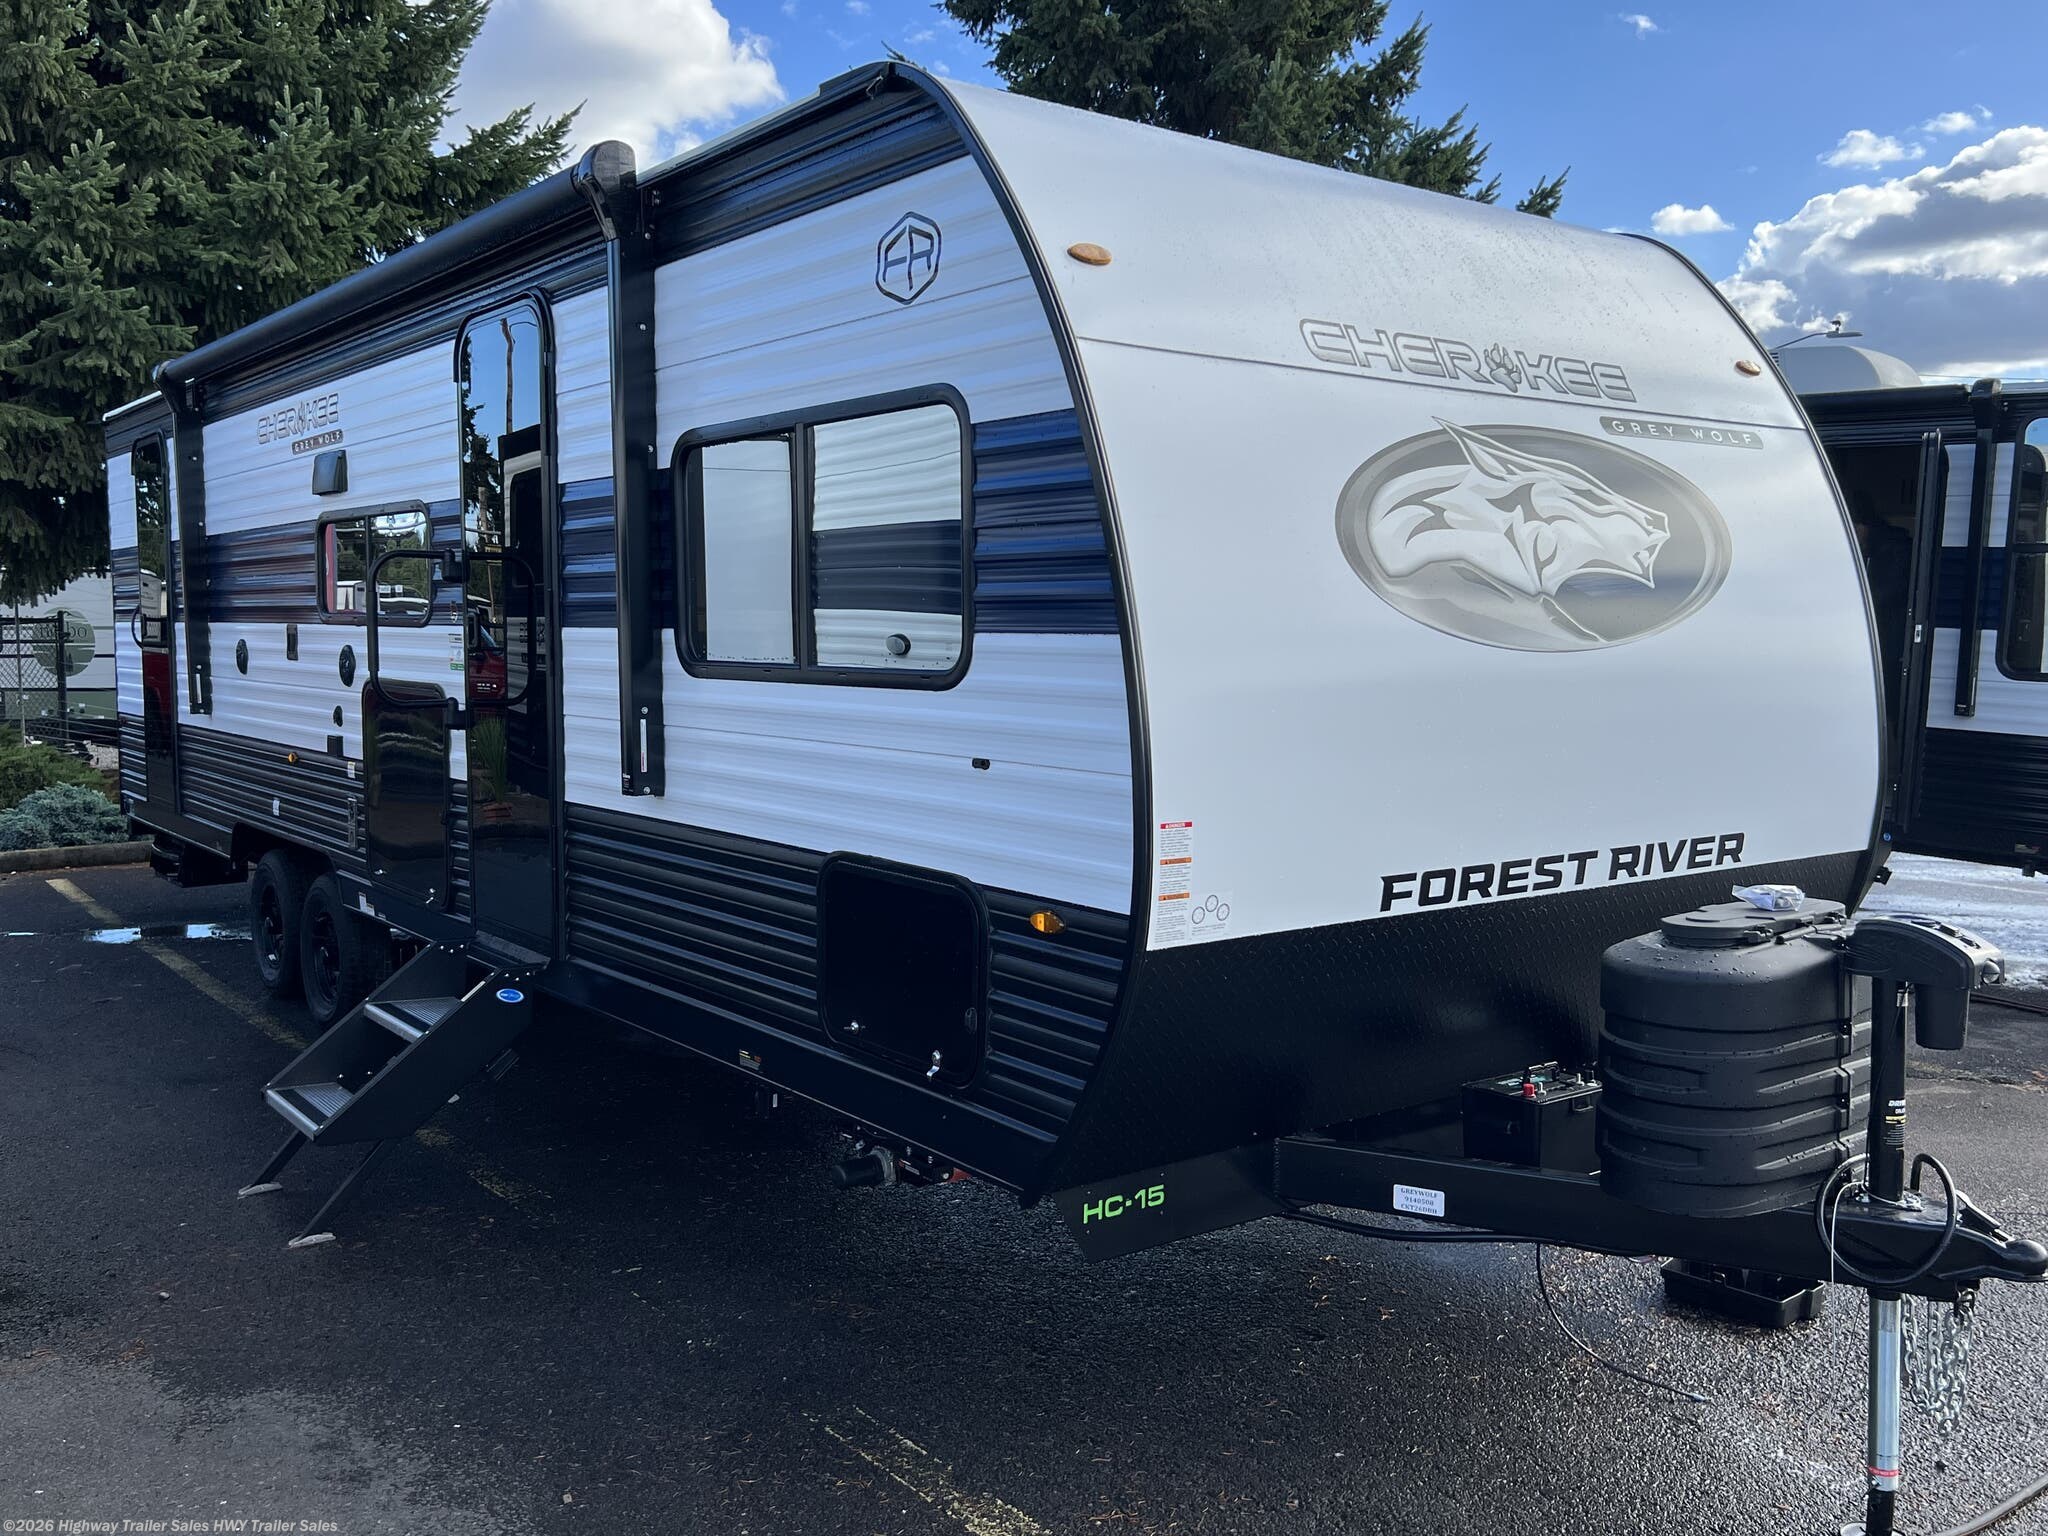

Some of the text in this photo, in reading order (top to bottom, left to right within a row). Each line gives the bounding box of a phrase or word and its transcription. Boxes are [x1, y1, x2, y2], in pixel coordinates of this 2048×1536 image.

[1299, 318, 1637, 402] CHEROKEE
[294, 431, 341, 452] GREY WOLF
[1611, 420, 1753, 445] GREY WOLF
[1379, 832, 1745, 912] FOREST RIVER
